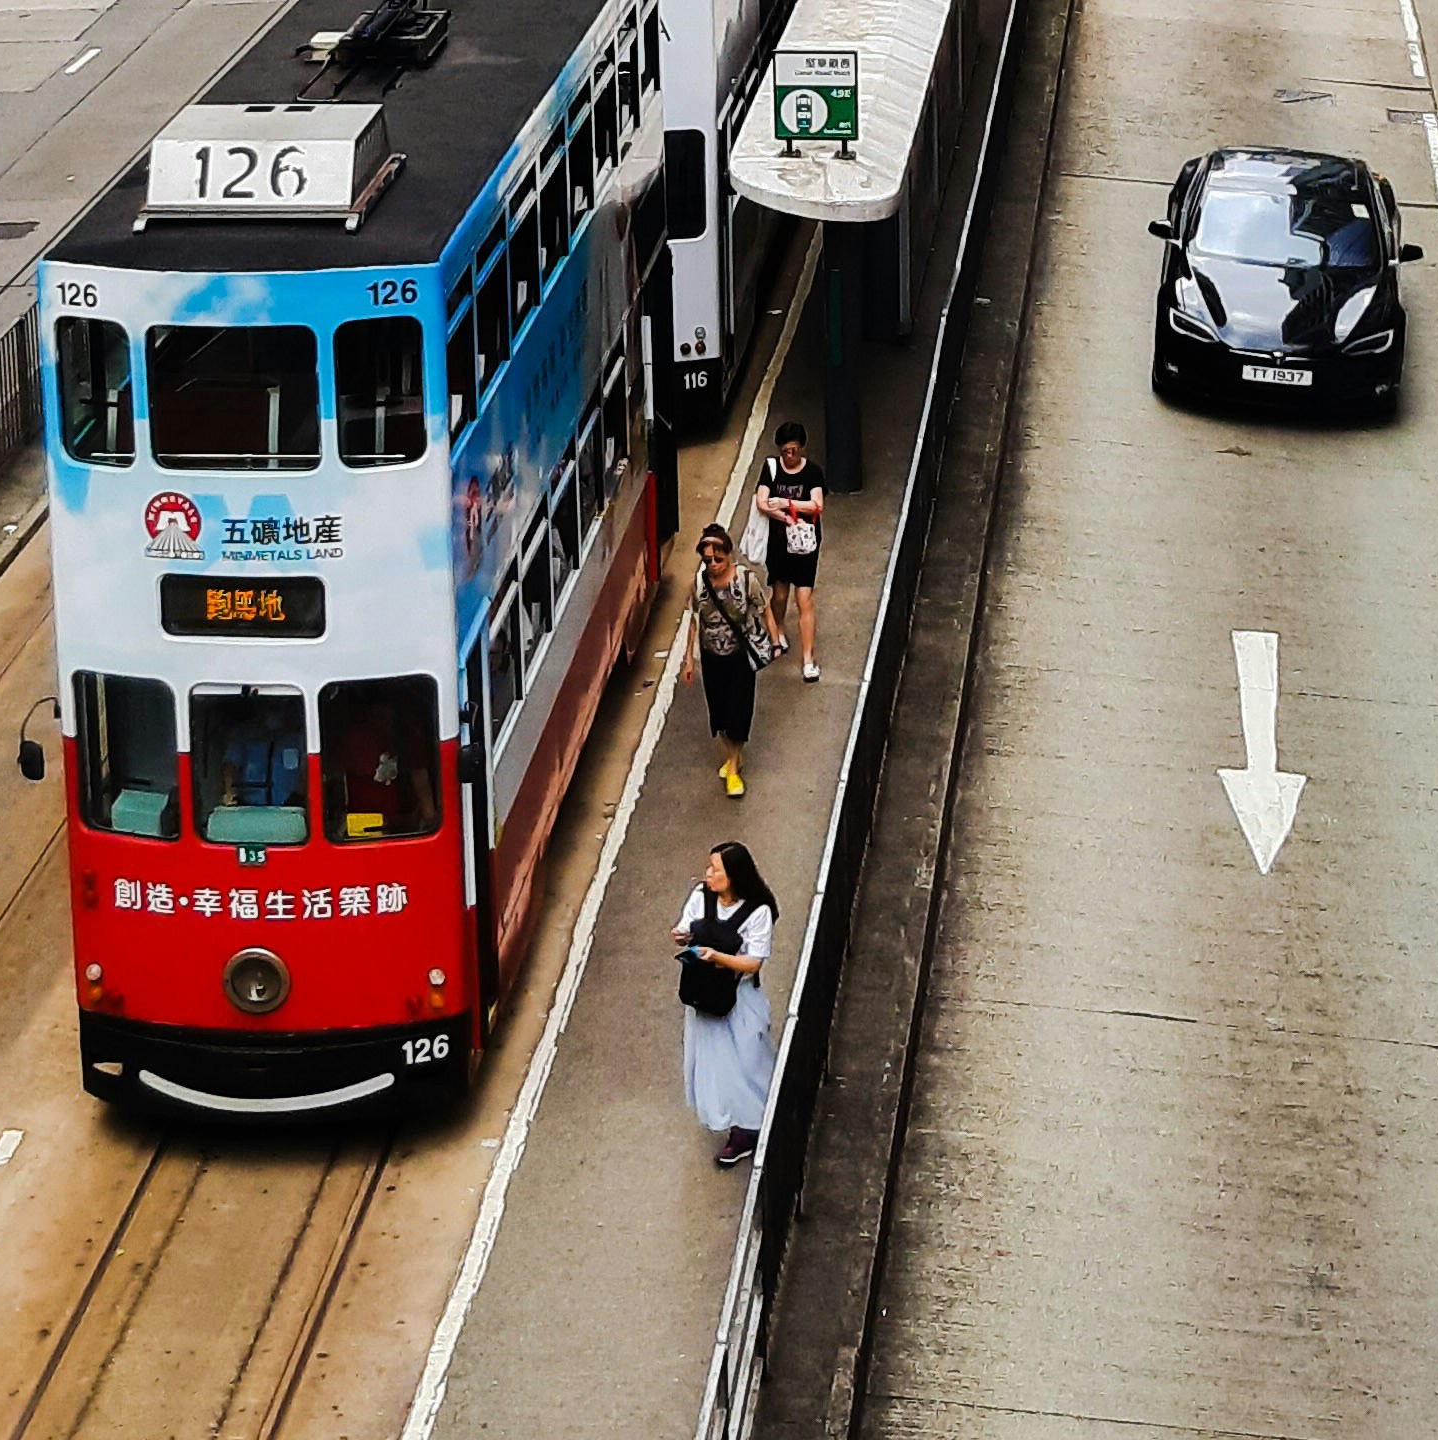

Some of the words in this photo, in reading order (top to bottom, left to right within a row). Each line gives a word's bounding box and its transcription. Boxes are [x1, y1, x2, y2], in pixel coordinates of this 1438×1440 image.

[193, 145, 308, 199] 126
[56, 282, 97, 308] 126
[367, 279, 418, 306] 126
[683, 372, 708, 390] 116
[1251, 367, 1269, 379] TT
[1273, 368, 1304, 383] 1937
[306, 547, 344, 560] LAND
[402, 1034, 450, 1065] 126
